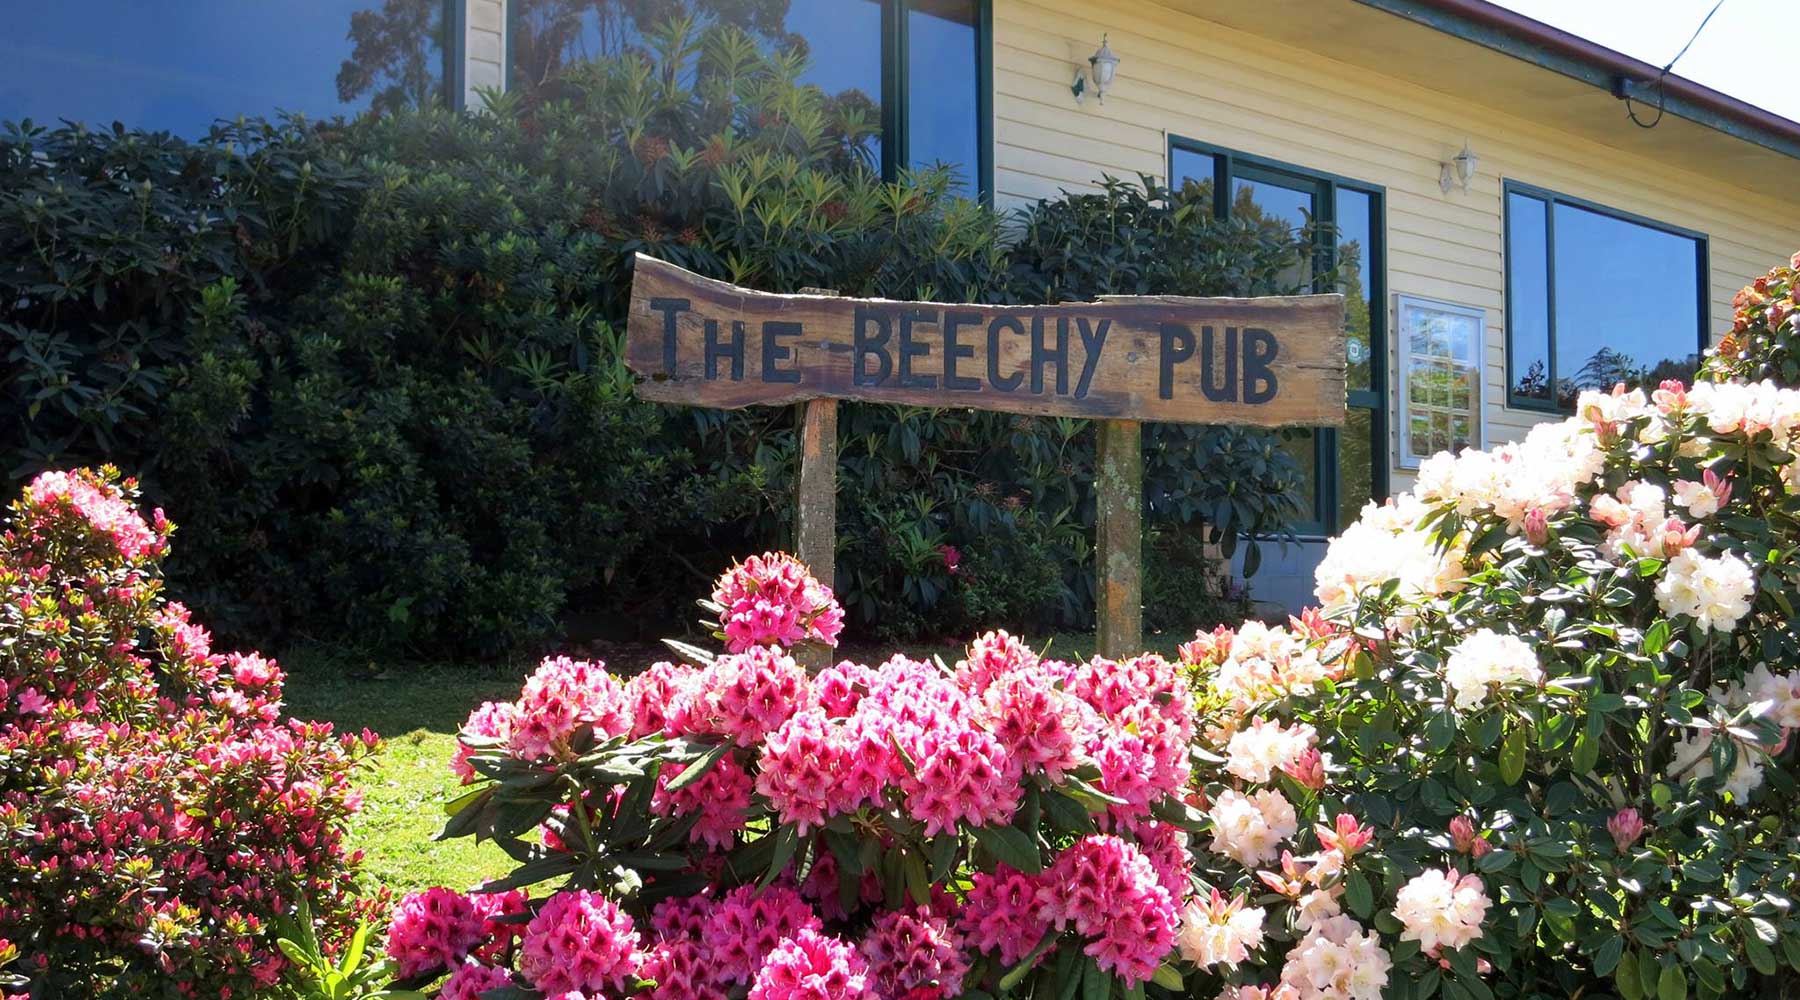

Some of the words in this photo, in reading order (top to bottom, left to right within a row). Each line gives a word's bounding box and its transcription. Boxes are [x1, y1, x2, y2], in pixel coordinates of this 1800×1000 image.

[650, 299, 802, 383] THE
[853, 306, 1112, 399] BEECHY
[1159, 322, 1279, 405] PUB
